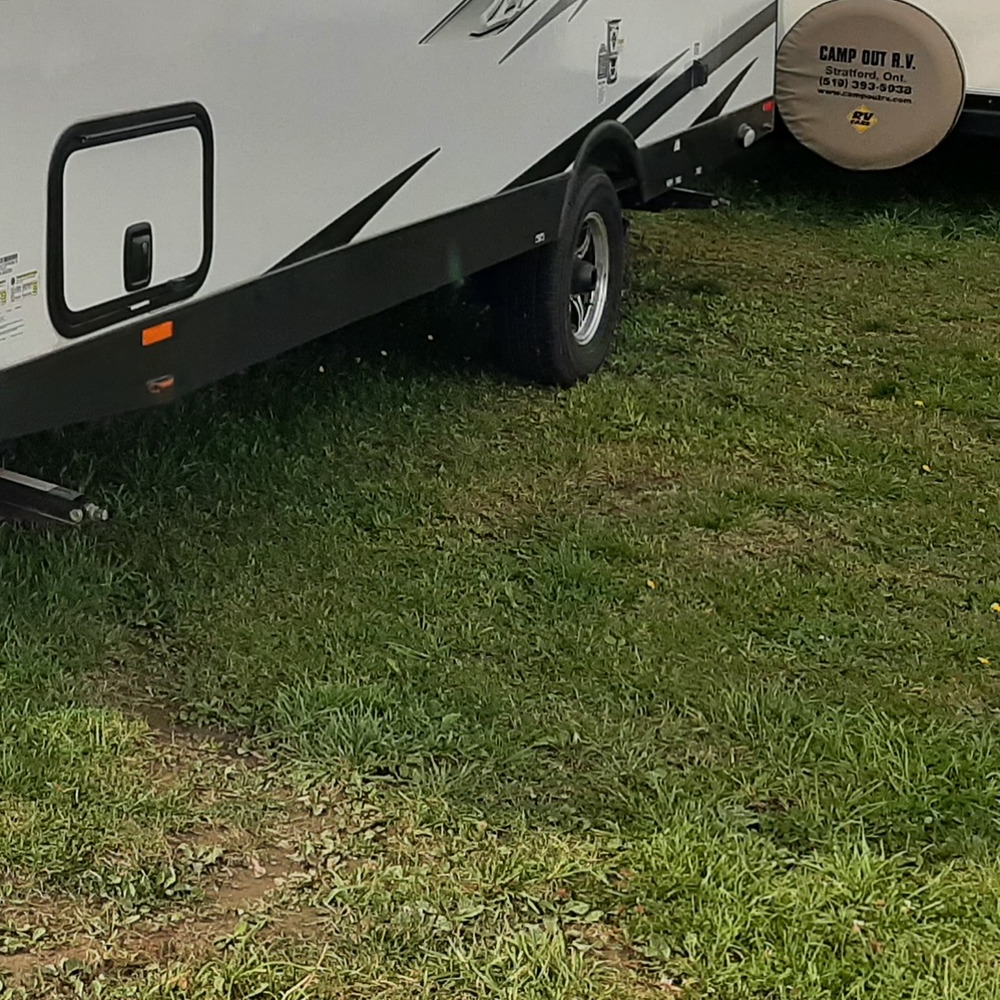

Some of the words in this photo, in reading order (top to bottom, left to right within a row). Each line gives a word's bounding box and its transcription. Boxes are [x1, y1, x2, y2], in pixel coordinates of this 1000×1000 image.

[819, 45, 857, 63] CAMP
[862, 49, 887, 67] OUT
[891, 52, 916, 70] R.V.
[819, 76, 848, 89] (519)
[852, 111, 874, 121] RV
